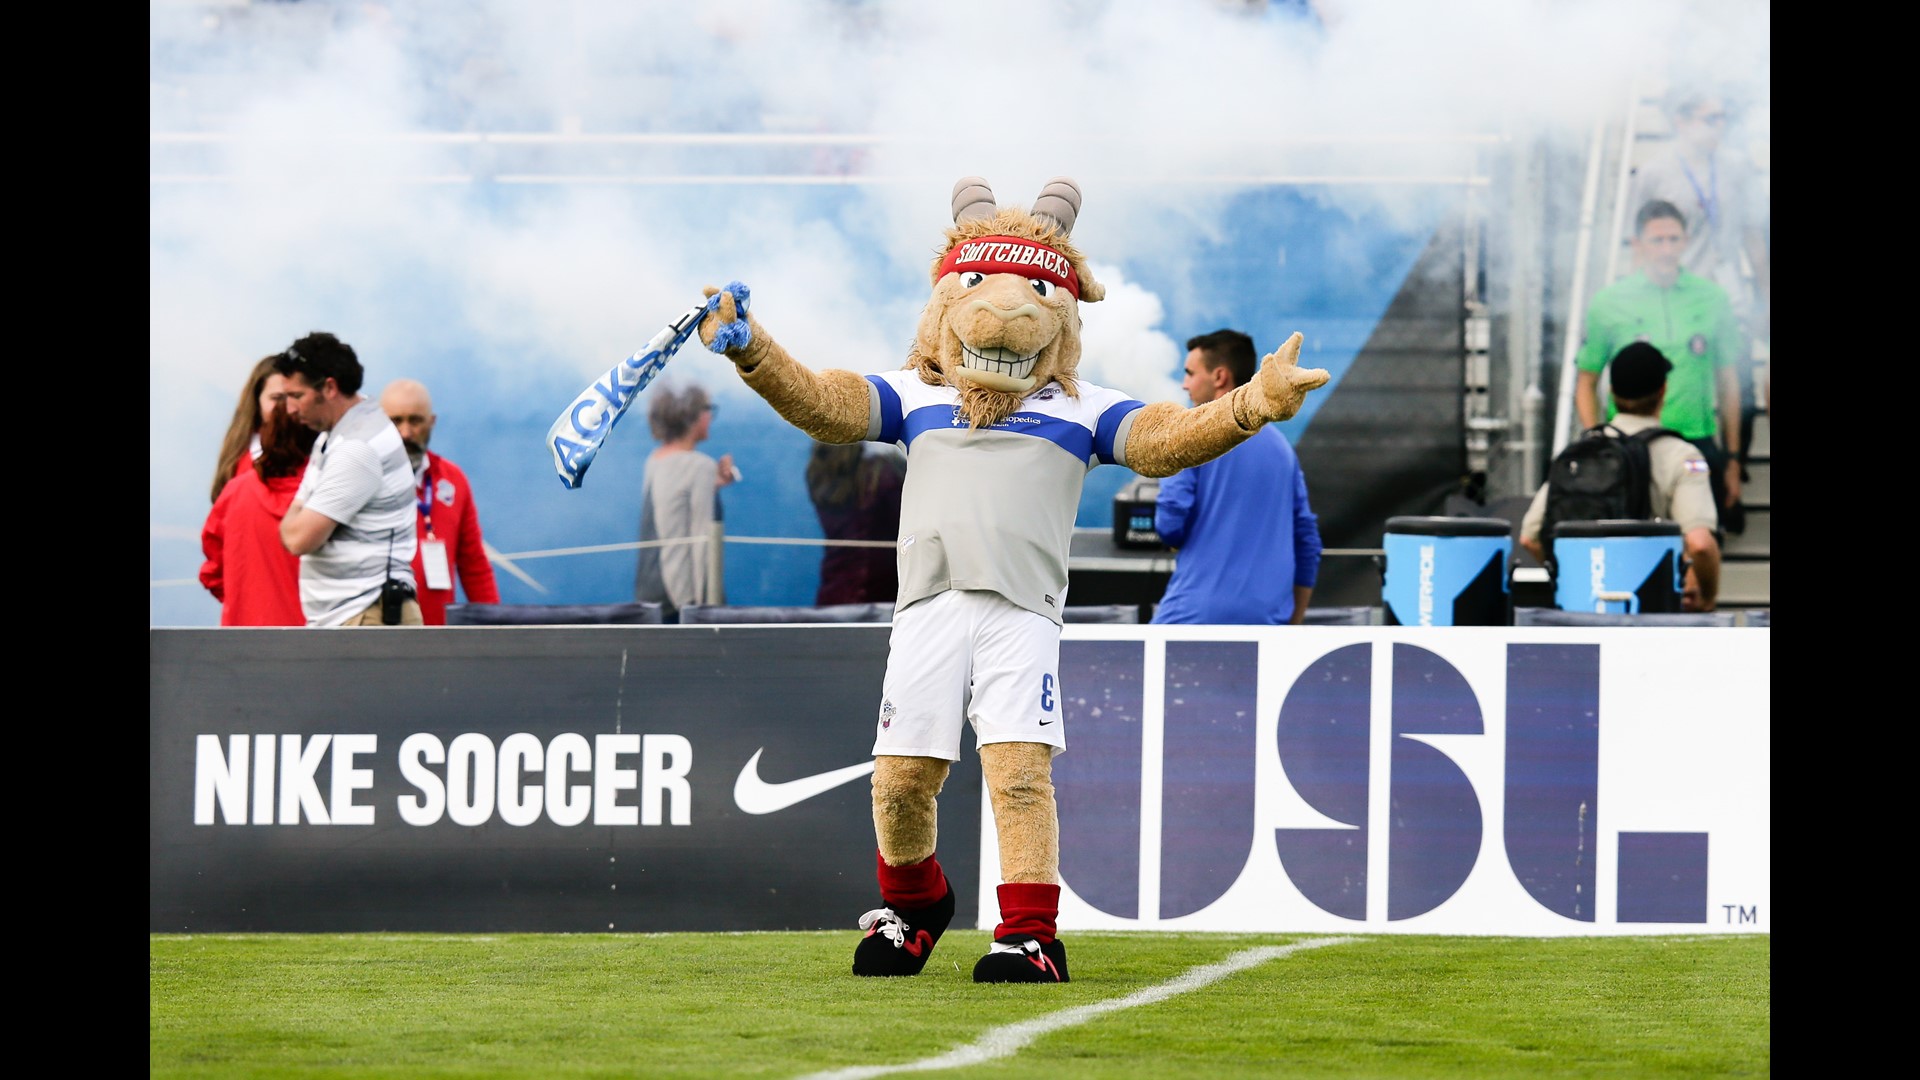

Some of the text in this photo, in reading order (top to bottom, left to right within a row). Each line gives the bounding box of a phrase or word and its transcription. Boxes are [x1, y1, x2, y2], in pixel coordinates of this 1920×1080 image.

[955, 242, 1070, 279] SWITCHBACKS
[1418, 545, 1435, 626] WERADE
[194, 731, 693, 827] NIKE SOCCER
[1058, 640, 1757, 924] USL TM
